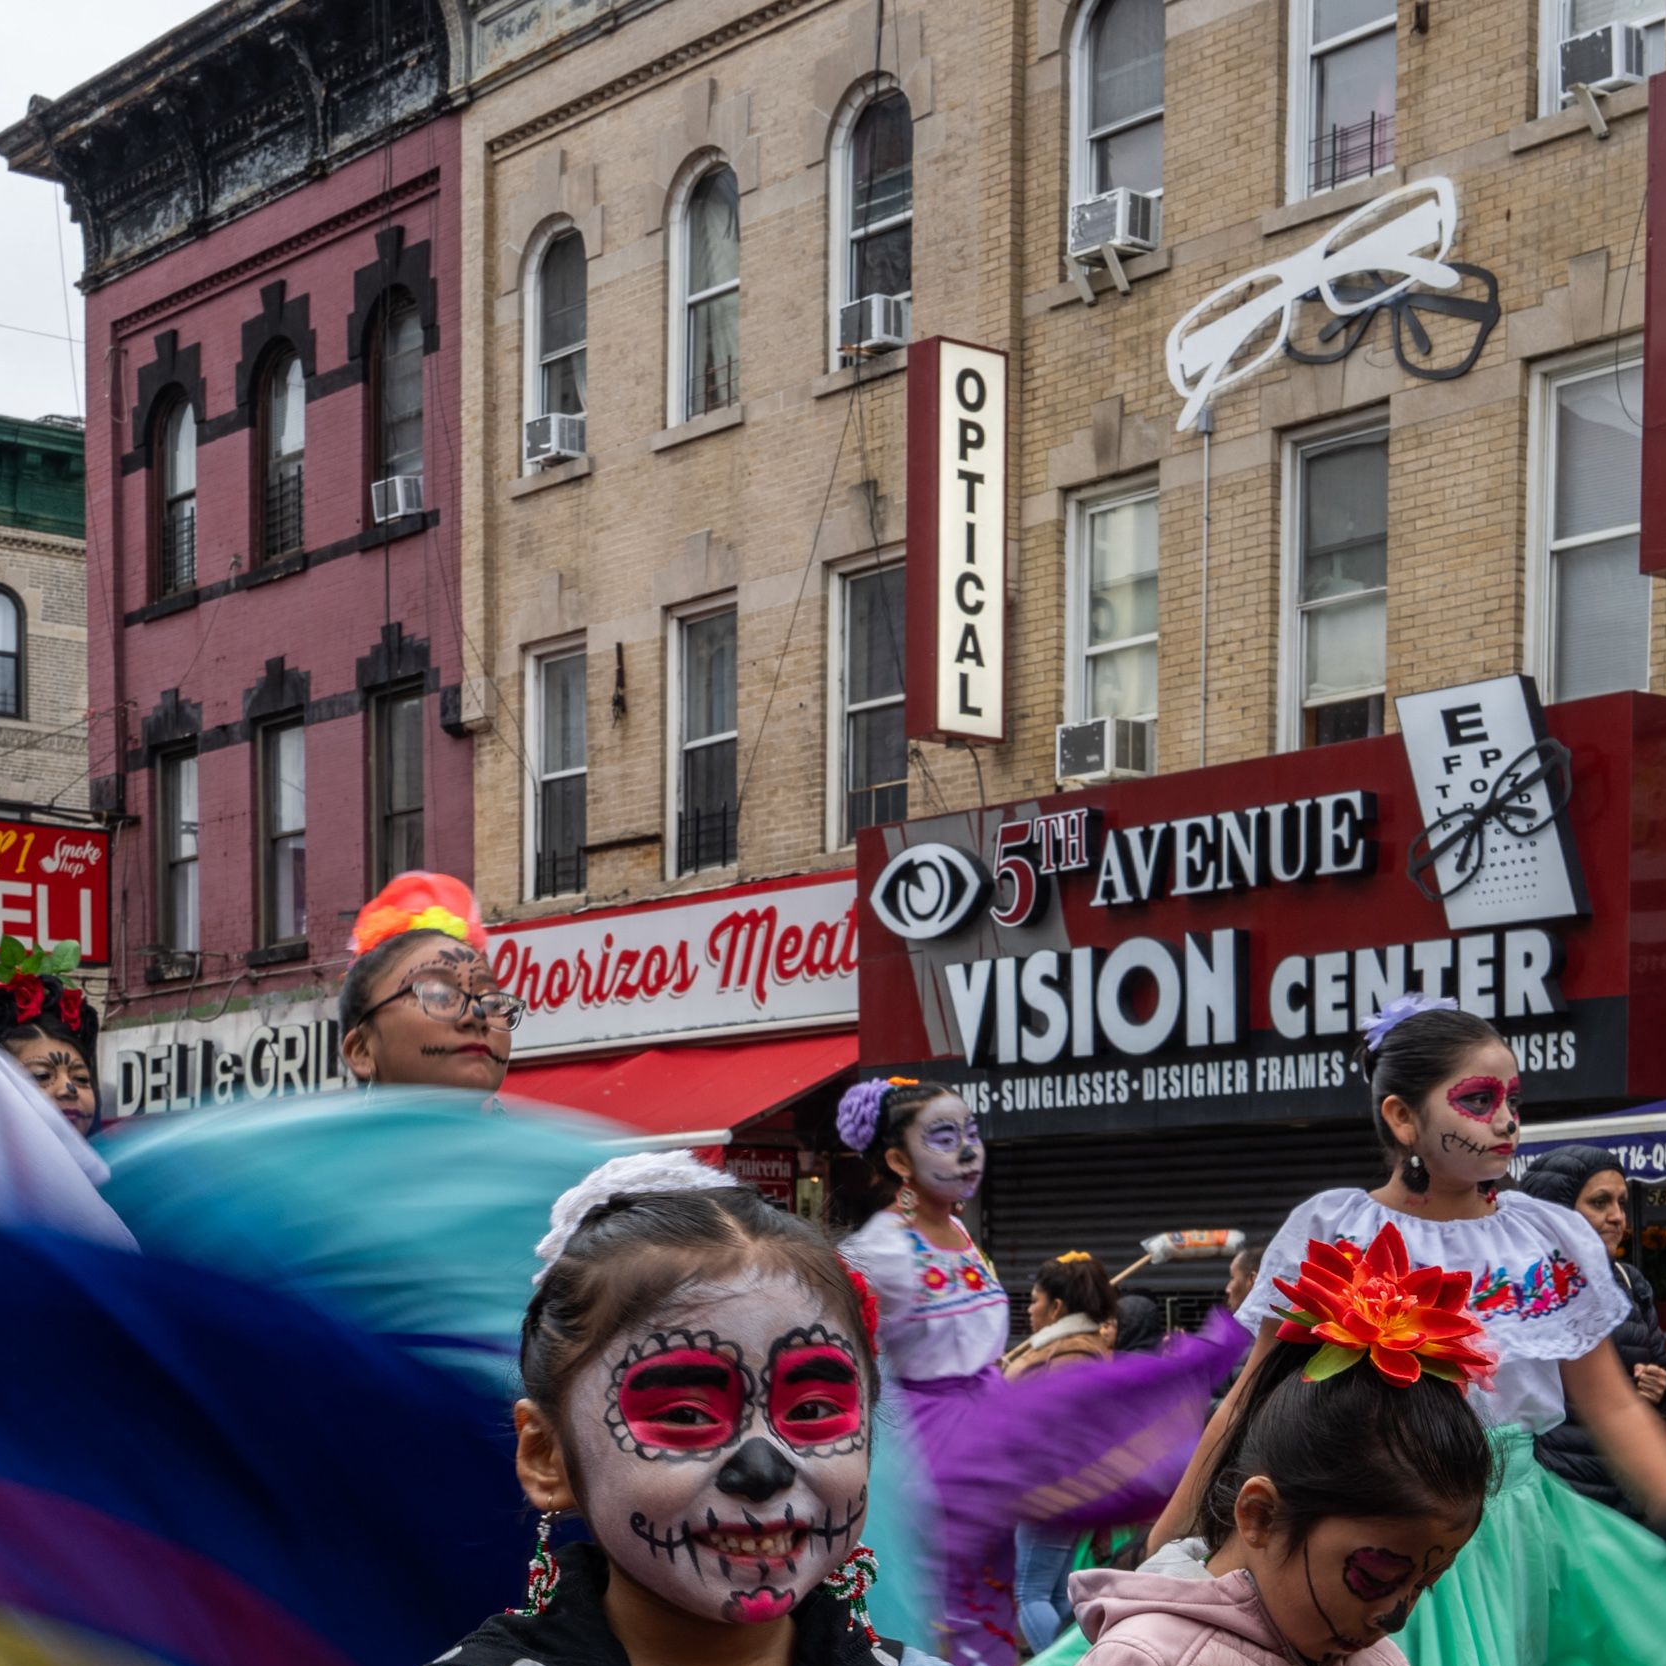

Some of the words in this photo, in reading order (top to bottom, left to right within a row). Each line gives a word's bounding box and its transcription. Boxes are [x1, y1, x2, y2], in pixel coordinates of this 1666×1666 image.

[954, 367, 987, 717] OPTICAL
[1440, 703, 1489, 747] E
[990, 807, 1089, 928] 5TH
[1090, 789, 1364, 907] AVENUE
[945, 928, 1236, 1068] VISION
[1270, 928, 1557, 1039] CENTER
[117, 1038, 203, 1117] DELI
[214, 1052, 235, 1105] &
[1001, 1069, 1130, 1111] SUNGLASSES
[1143, 1060, 1248, 1101] DESIGNER
[1256, 1051, 1345, 1093] FRAMES
[1503, 1030, 1576, 1072] NSES
